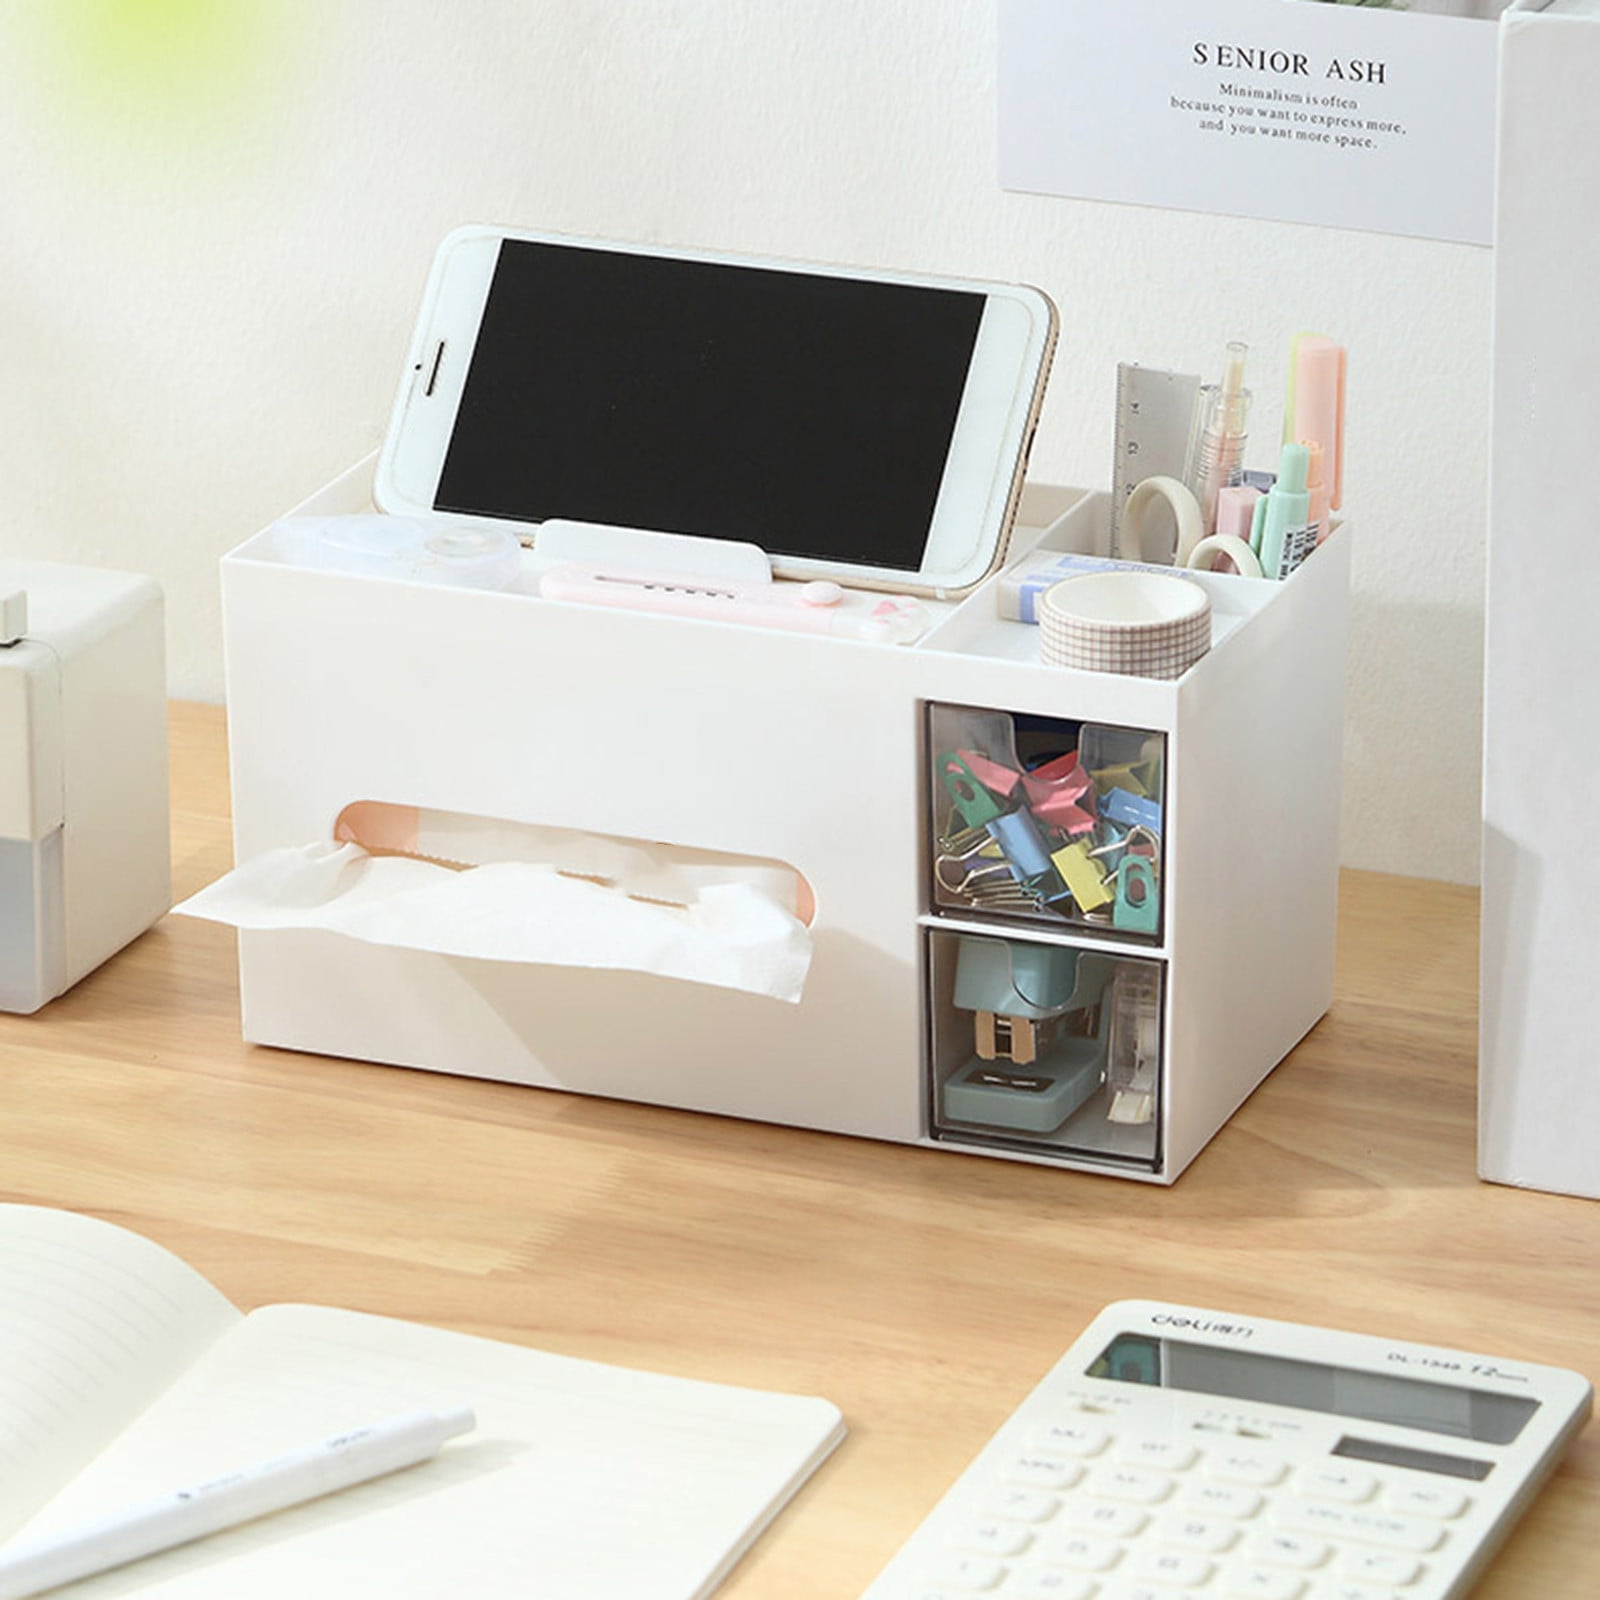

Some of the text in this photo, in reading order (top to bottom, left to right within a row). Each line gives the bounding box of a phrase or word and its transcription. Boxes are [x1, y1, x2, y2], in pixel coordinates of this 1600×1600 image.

[1193, 42, 1387, 85] SENIOR ASH
[1219, 83, 1358, 110] Minimalism is often
[1170, 95, 1407, 135] because you want to express more.
[1199, 119, 1378, 149] and you want more space.
[1130, 402, 1140, 416] 14
[1127, 441, 1139, 455] 13
